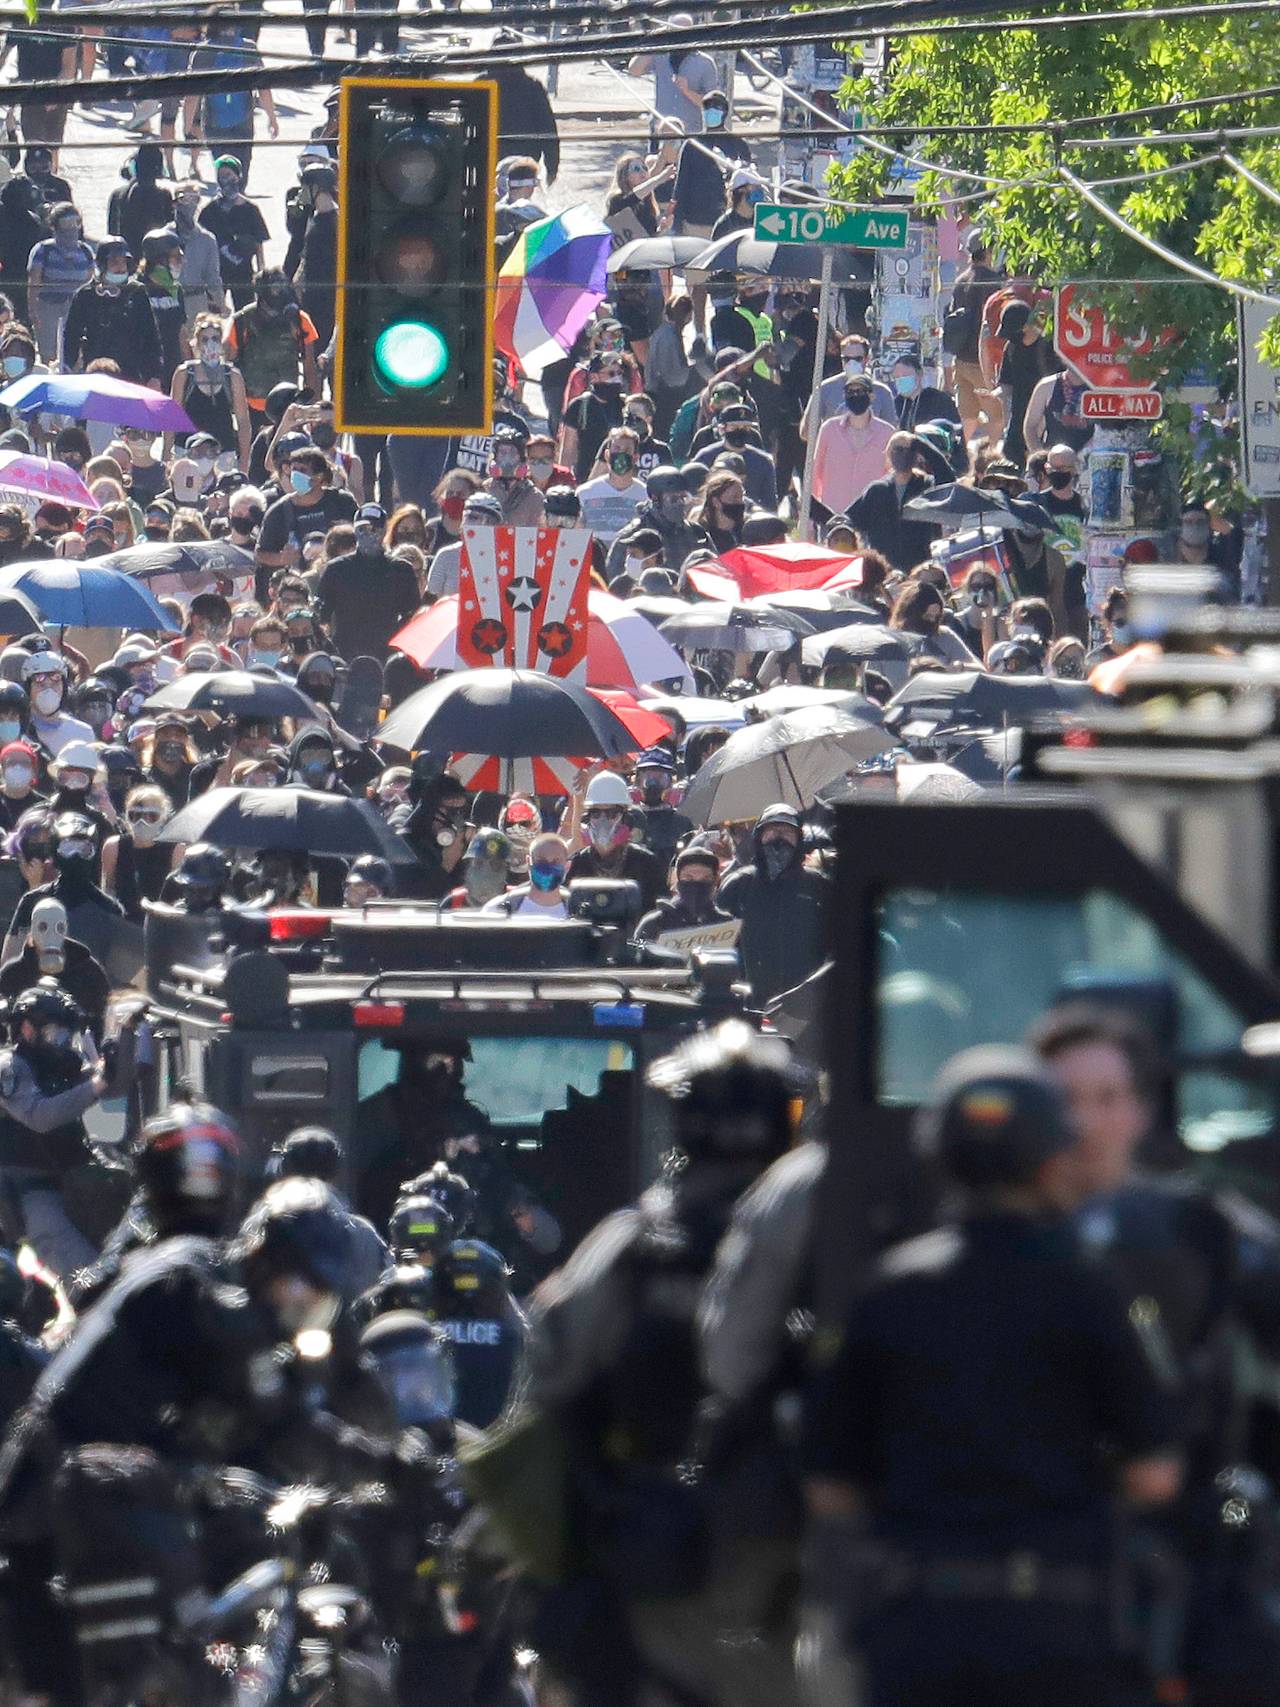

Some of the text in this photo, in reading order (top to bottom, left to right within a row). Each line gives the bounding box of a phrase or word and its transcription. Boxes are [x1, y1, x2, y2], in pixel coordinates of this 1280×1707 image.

[865, 219, 900, 239] Ave
[1088, 398, 1154, 412] ALL WAY
[460, 435, 492, 456] LIVE
